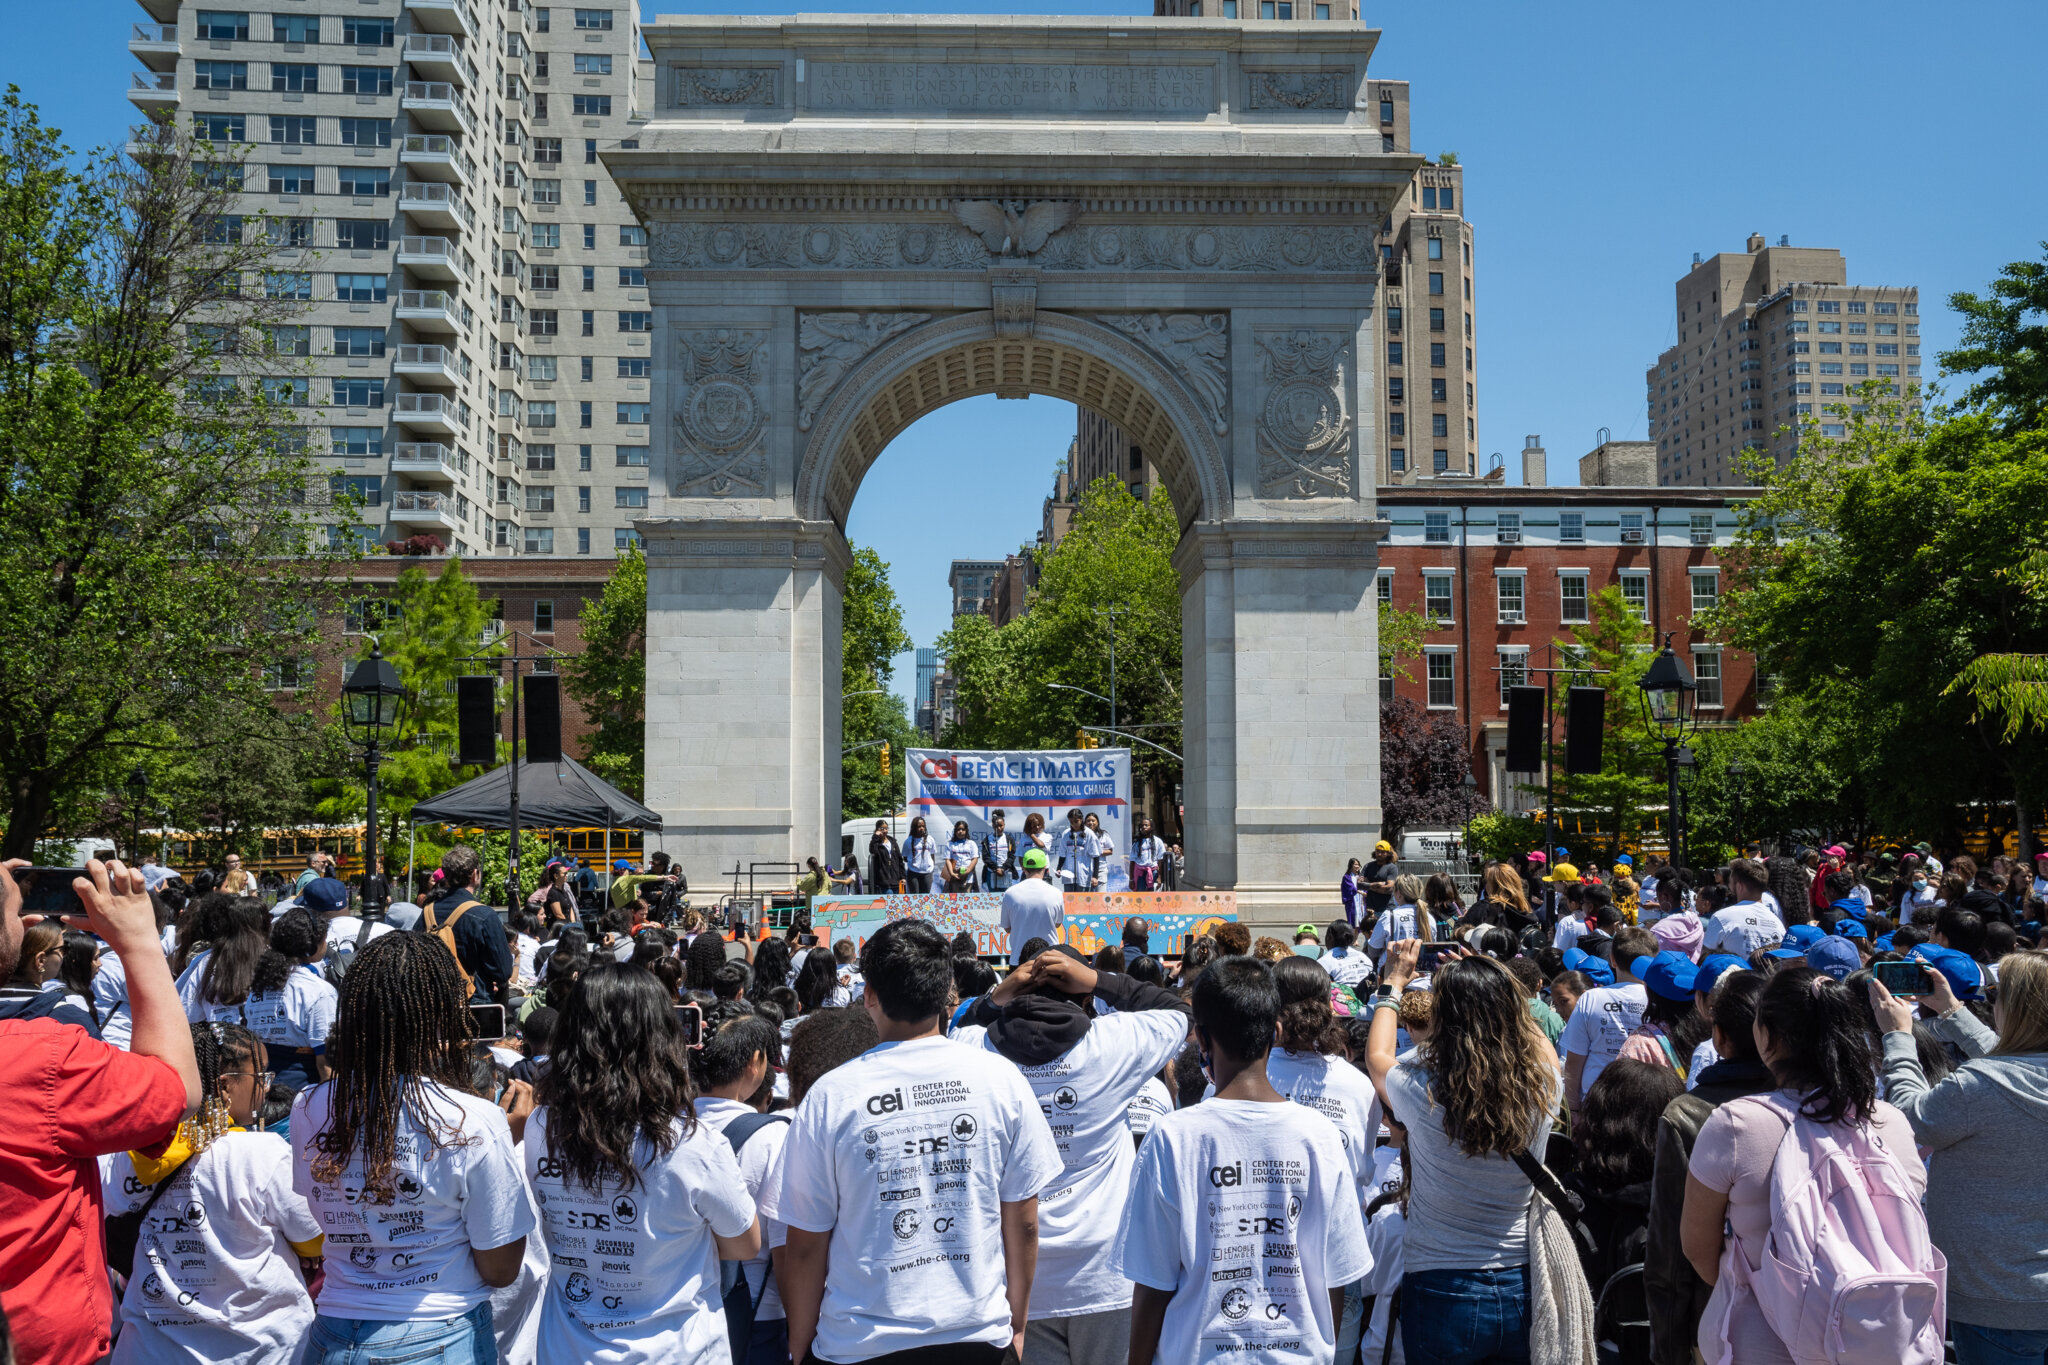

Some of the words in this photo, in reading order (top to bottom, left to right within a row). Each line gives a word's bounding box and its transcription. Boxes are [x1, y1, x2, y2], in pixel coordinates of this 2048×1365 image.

[821, 65, 850, 78] LET
[856, 65, 874, 78] US
[880, 65, 925, 78] RAISE
[929, 66, 940, 78] A
[949, 66, 1034, 79] STANDARD
[1040, 67, 1062, 80] TO
[1069, 67, 1122, 80] WHICH
[1127, 68, 1159, 80] THE
[1166, 68, 1203, 81] WISE
[821, 79, 853, 92] AND
[861, 80, 892, 92] THE
[902, 80, 968, 92] HONEST
[978, 81, 1013, 93] CAN
[1021, 81, 1078, 93] REPAIR
[1106, 81, 1138, 94] THE
[1149, 82, 1205, 94] EVENT
[821, 93, 833, 105] IS
[840, 93, 854, 105] IN
[862, 93, 896, 105] THE
[904, 93, 951, 105] HAND
[959, 93, 979, 105] OF
[988, 94, 1023, 106] GOD
[1092, 95, 1206, 108] WASHINGTON
[920, 755, 957, 779] cei
[961, 760, 1116, 779] BENCHMARKS
[923, 783, 947, 795] YOUTH
[950, 784, 979, 796] SETTING
[981, 784, 995, 796] THE
[998, 784, 1036, 797] STANDARD
[1038, 784, 1053, 796] FOR
[1055, 784, 1081, 796] SOCIAL
[1083, 783, 1113, 796] CHANGE
[1745, 917, 1757, 926] cei
[1603, 1000, 1623, 1012] cei
[1022, 1070, 1067, 1078] NNOVATION
[867, 1087, 904, 1115] cei
[912, 1082, 944, 1092] CENTER
[913, 1087, 971, 1100] EDUCATIONAL
[914, 1095, 966, 1108] INNOVATION
[1300, 1094, 1326, 1103] CENTER
[1328, 1098, 1341, 1106] FOR
[896, 1128, 911, 1136] York
[911, 1125, 924, 1134] City
[890, 1164, 922, 1174] LENOBLE
[1210, 1160, 1242, 1188] cei
[1252, 1160, 1284, 1168] CENTER
[1286, 1160, 1300, 1168] FOR
[1252, 1168, 1306, 1177] EDUCATIONAL
[891, 1171, 922, 1181] LUMBER
[1252, 1176, 1302, 1184] INNOVATION
[575, 1196, 586, 1205] City
[881, 1191, 902, 1201] ultra
[903, 1188, 920, 1198] site
[1247, 1203, 1259, 1211] City
[1260, 1202, 1284, 1210] Council
[1224, 1244, 1255, 1254] LENOBLE
[1224, 1251, 1255, 1260] LUMBER
[890, 1252, 970, 1273] www.the-cei.org
[1213, 1271, 1233, 1281] ultra
[1234, 1268, 1251, 1278] site
[1215, 1340, 1300, 1352] www.the-cei.org
